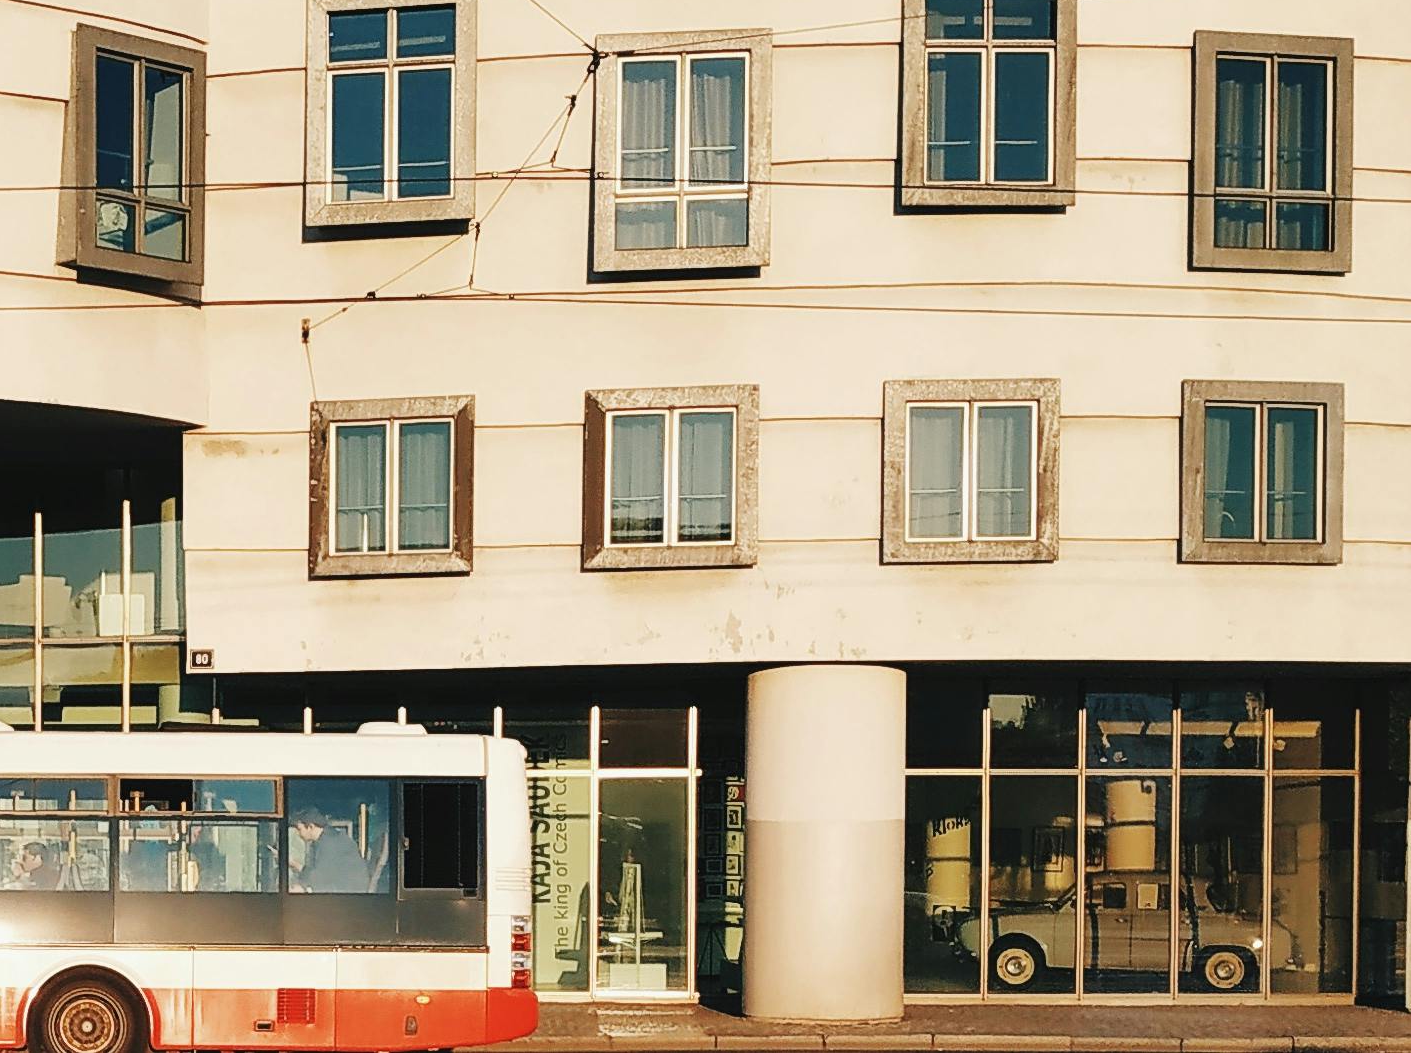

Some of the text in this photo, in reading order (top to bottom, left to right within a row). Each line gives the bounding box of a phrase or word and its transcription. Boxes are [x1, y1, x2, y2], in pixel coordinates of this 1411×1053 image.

[195, 653, 209, 665] 80
[552, 733, 572, 959] The king of Czech Comics
